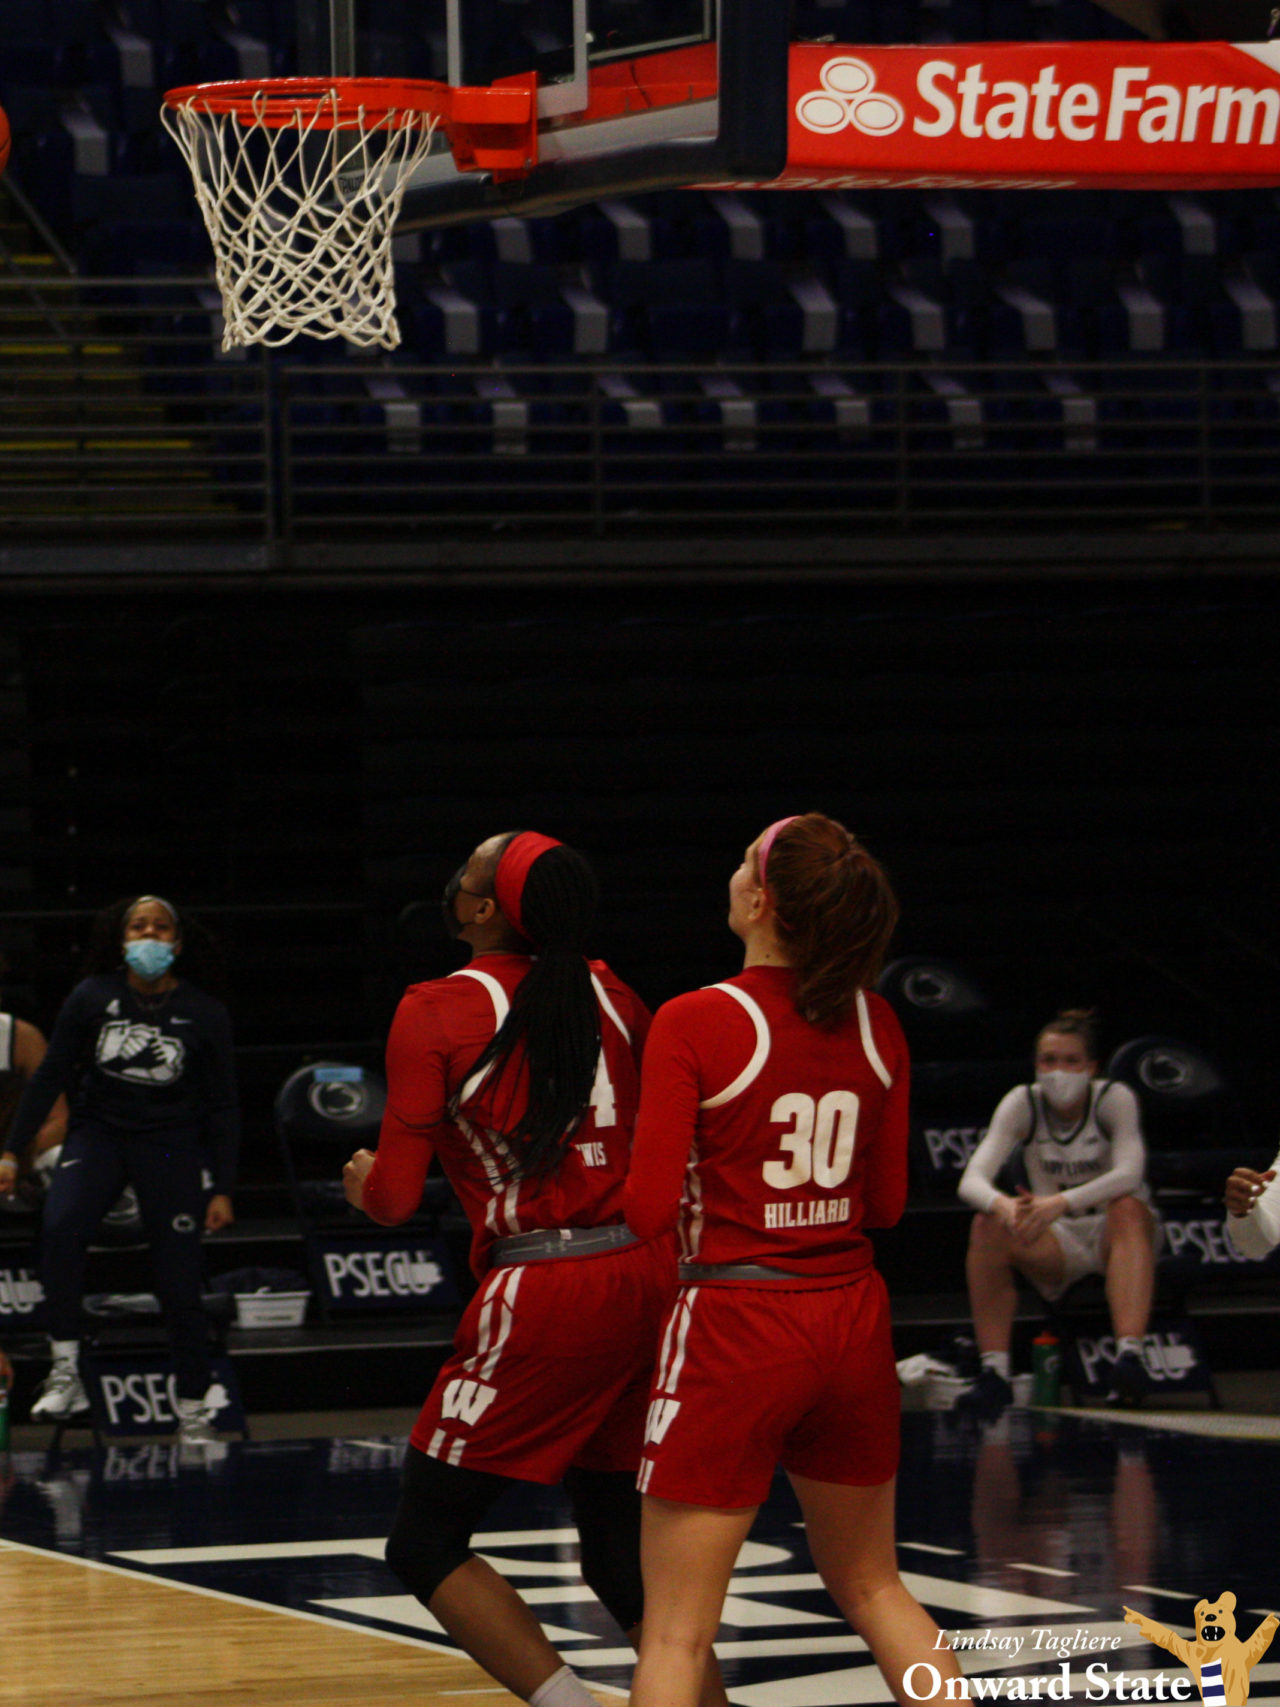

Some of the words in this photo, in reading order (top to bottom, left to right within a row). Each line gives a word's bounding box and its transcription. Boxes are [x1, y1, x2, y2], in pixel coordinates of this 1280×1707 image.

[575, 1141, 607, 1167] WIS
[762, 1089, 860, 1190] 30
[764, 1197, 850, 1229] HILLIARD
[441, 1378, 498, 1427] W
